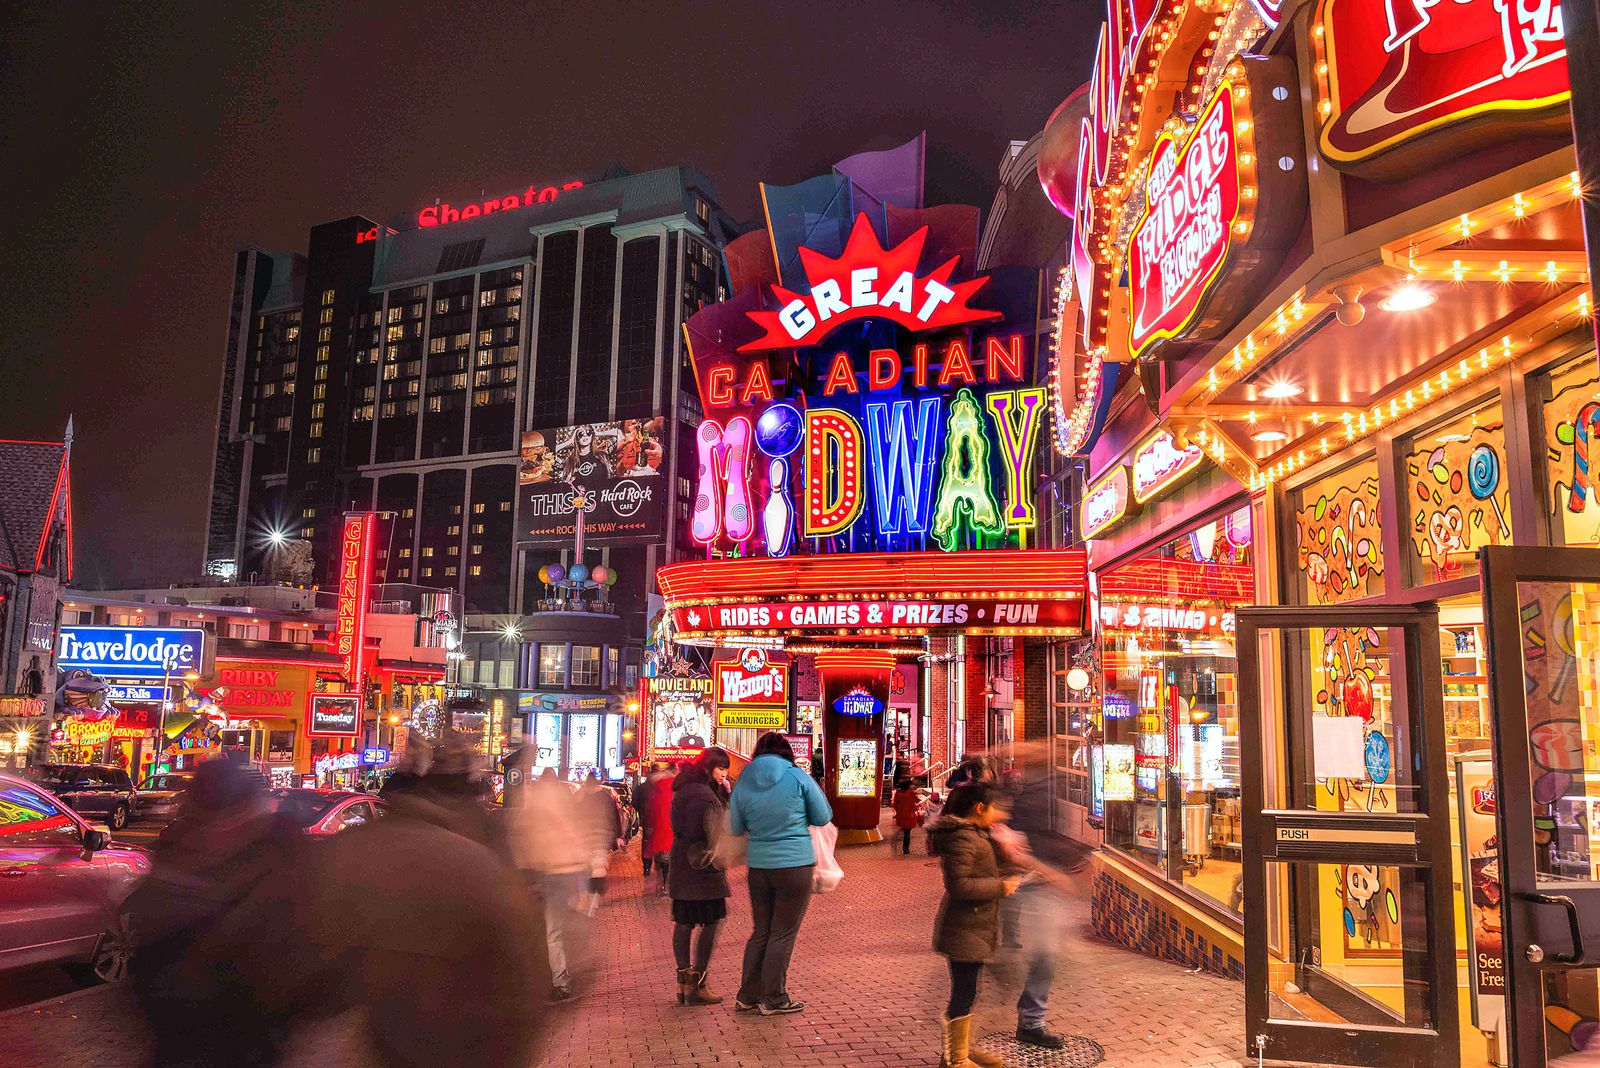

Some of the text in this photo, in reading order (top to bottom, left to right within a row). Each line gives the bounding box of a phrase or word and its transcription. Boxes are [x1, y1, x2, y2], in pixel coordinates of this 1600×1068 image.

[1137, 100, 1228, 289] FUDGE
[778, 267, 956, 340] GREAT
[601, 486, 652, 503] Hard Rock
[531, 493, 575, 516] THIS
[556, 522, 617, 535] ROCK HIS WAY
[720, 603, 1038, 626] RIDES GAMES & PRIZES FUN
[59, 633, 193, 670] Travelodge
[221, 669, 279, 687] RUBY
[649, 678, 713, 694] MOVIELAND
[722, 668, 783, 702] Wendy's
[126, 687, 150, 698] Falls
[317, 713, 354, 723] Tuesday
[319, 706, 341, 716] Ruby
[725, 717, 779, 725] HAMBURGERS
[1281, 829, 1309, 839] PUSH
[1478, 953, 1502, 969] See
